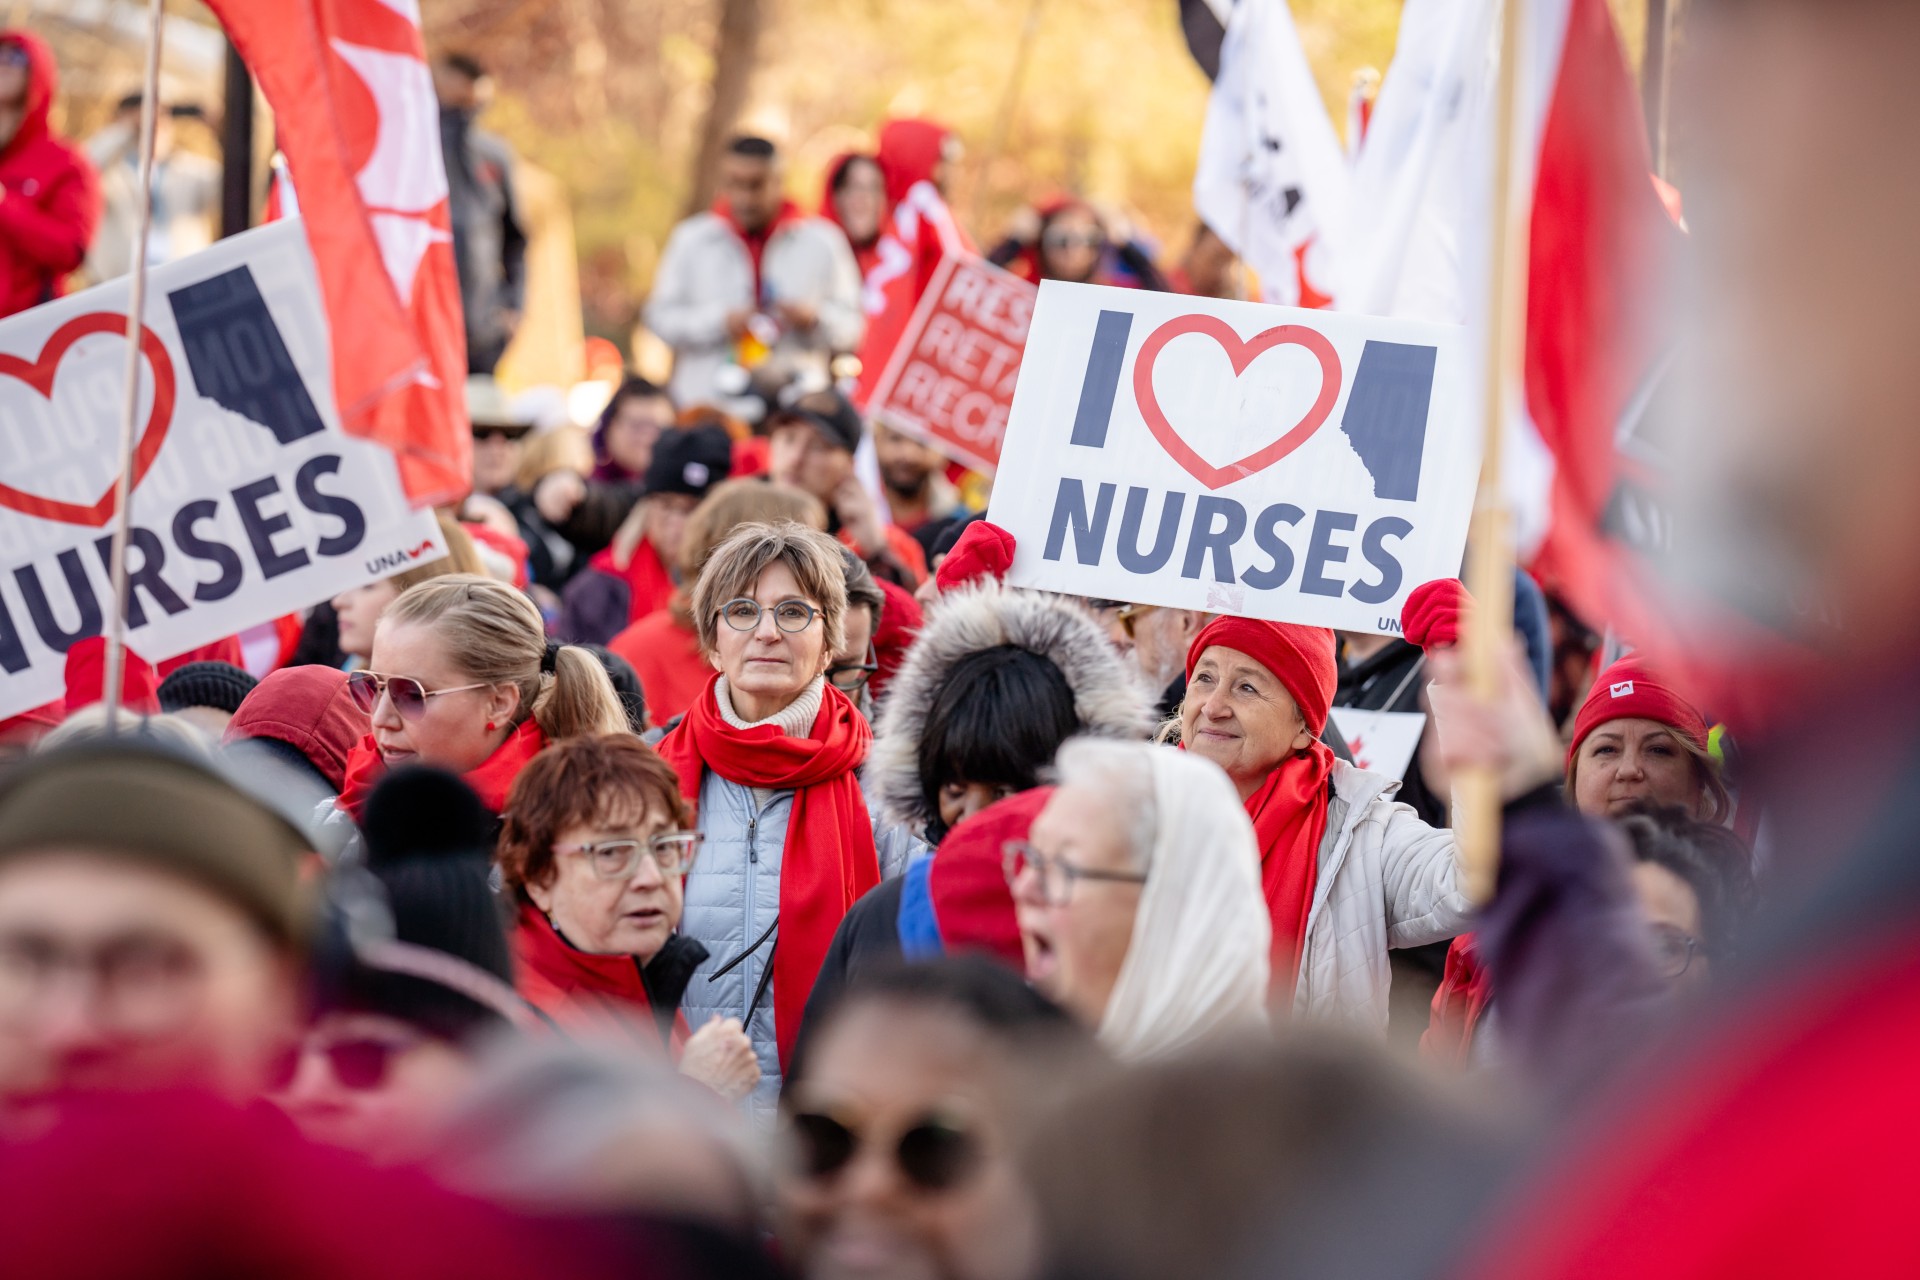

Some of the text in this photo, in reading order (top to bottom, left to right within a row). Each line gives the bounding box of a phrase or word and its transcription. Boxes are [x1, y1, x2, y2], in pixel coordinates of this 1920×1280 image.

[1070, 309, 1134, 449] I
[366, 550, 409, 575] UNA
[1042, 477, 1415, 605] NURSES
[1378, 616, 1403, 633] UN
